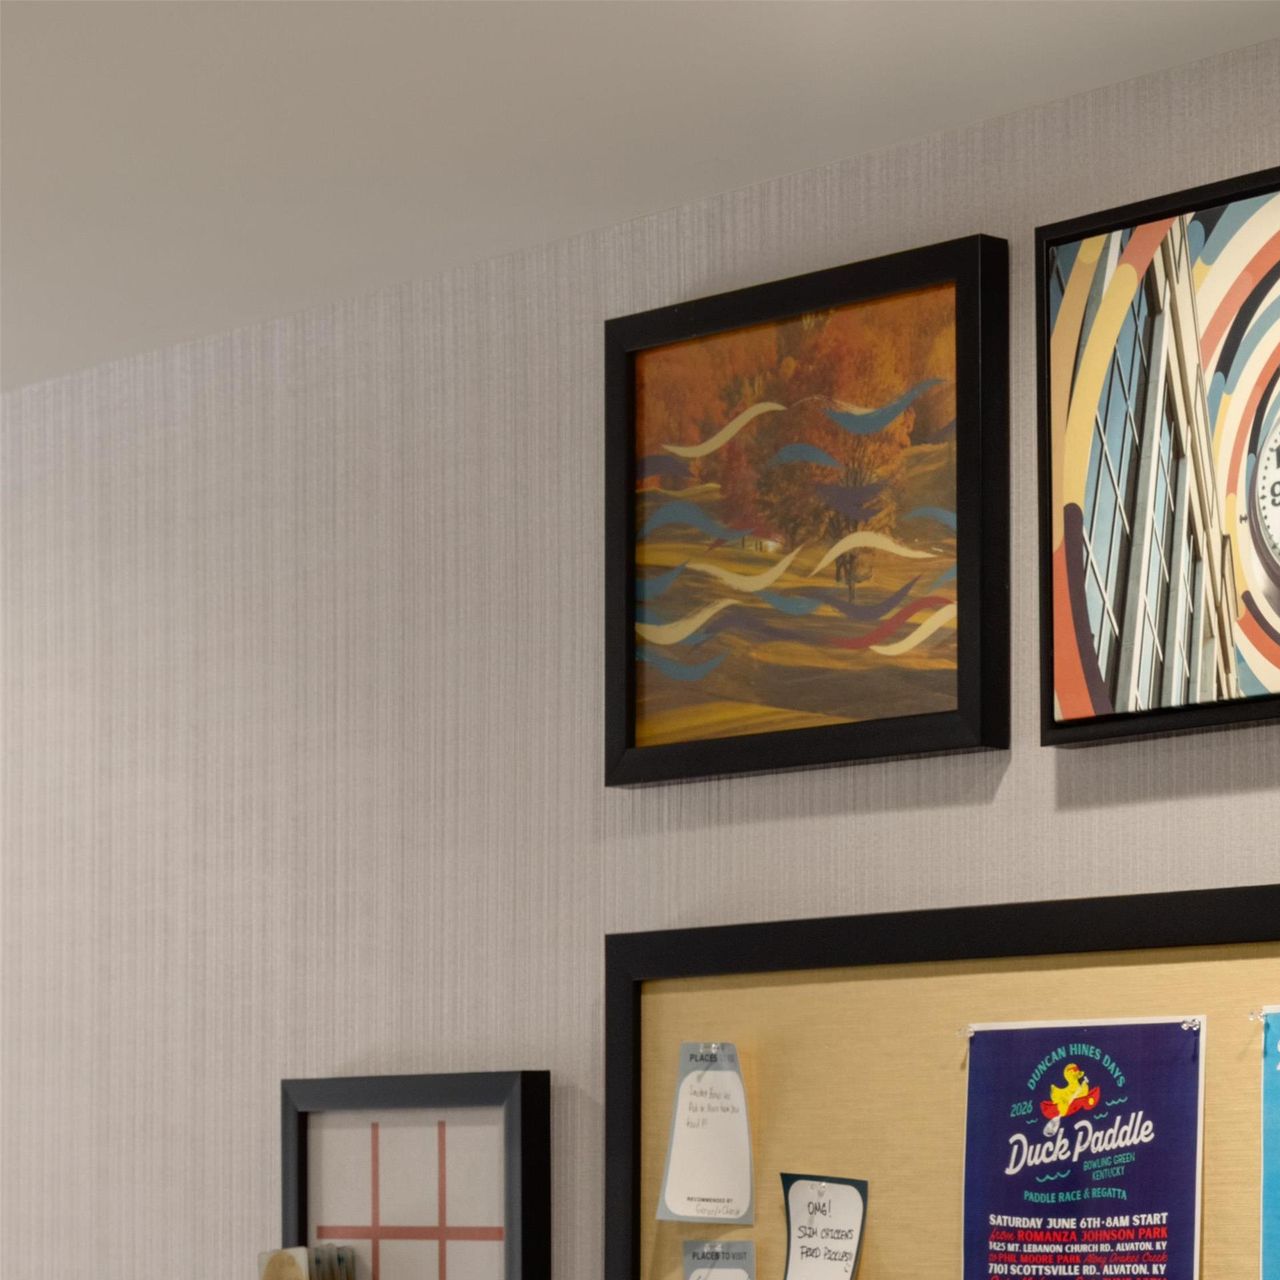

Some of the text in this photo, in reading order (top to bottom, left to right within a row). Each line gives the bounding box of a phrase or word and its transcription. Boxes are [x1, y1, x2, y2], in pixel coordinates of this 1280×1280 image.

[1027, 1043, 1126, 1091] DUNCAN HINES DAYS
[1010, 1101, 1033, 1117] 2026
[1005, 1111, 1155, 1175] Duck Paddle
[1024, 1188, 1127, 1203] PADDLE RACE & REGATTA
[989, 1212, 1168, 1229] SATURDAY JUNE 6TH 8AM START
[988, 1264, 1008, 1274] 7101
[1010, 1265, 1080, 1275] SCOTTSVILLE
